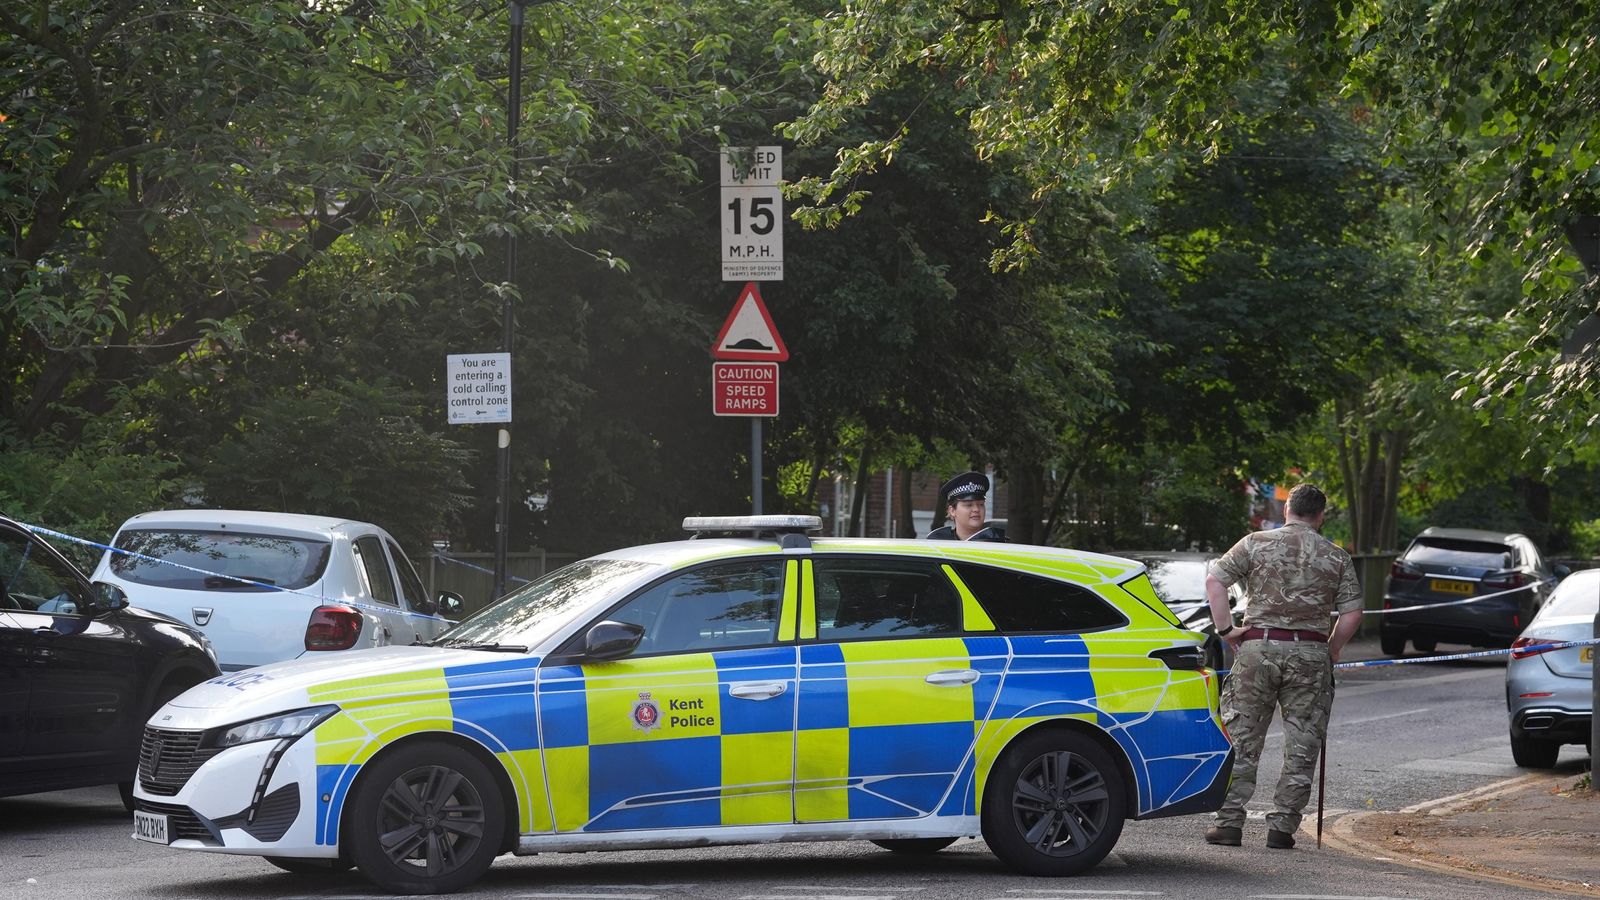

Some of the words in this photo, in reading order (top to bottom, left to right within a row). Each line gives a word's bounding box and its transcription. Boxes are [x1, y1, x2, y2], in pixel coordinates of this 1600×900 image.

[732, 168, 771, 180] LMIT
[728, 197, 775, 235] 15
[729, 245, 775, 258] M.P.H.
[461, 358, 478, 367] You
[481, 359, 496, 367] are
[455, 370, 494, 382] entering
[497, 371, 503, 379] a
[718, 368, 773, 379] CAUTION
[453, 383, 472, 393] cold
[475, 382, 506, 395] calling
[726, 385, 766, 396] SPEED
[451, 395, 484, 406] control
[486, 397, 508, 405] zone
[725, 398, 767, 410] RAMPS
[669, 698, 704, 711] Kent
[670, 714, 715, 728] Police
[150, 817, 165, 840] BXH
